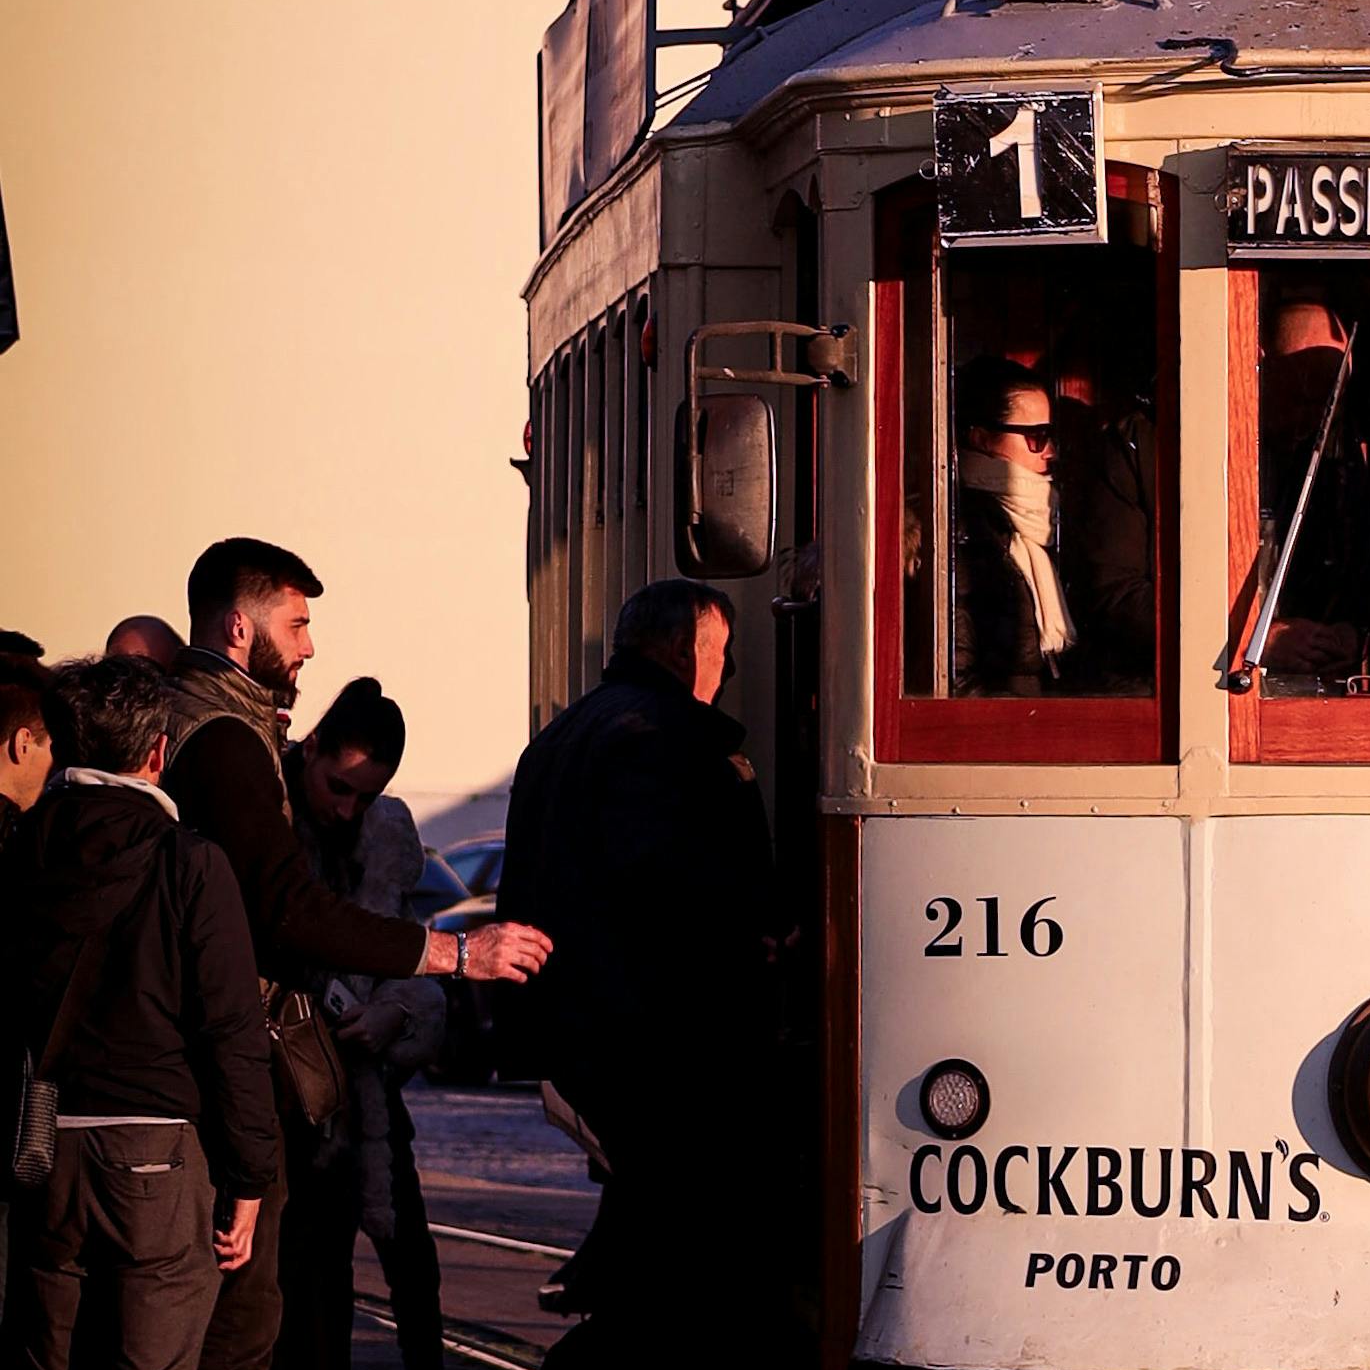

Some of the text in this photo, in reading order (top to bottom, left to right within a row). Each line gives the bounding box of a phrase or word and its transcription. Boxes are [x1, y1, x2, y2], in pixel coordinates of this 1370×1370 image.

[987, 104, 1043, 219] 1
[923, 896, 1064, 957] 216
[908, 1134, 1322, 1222] COCKBURN'S
[1024, 1253, 1182, 1292] PORTO
